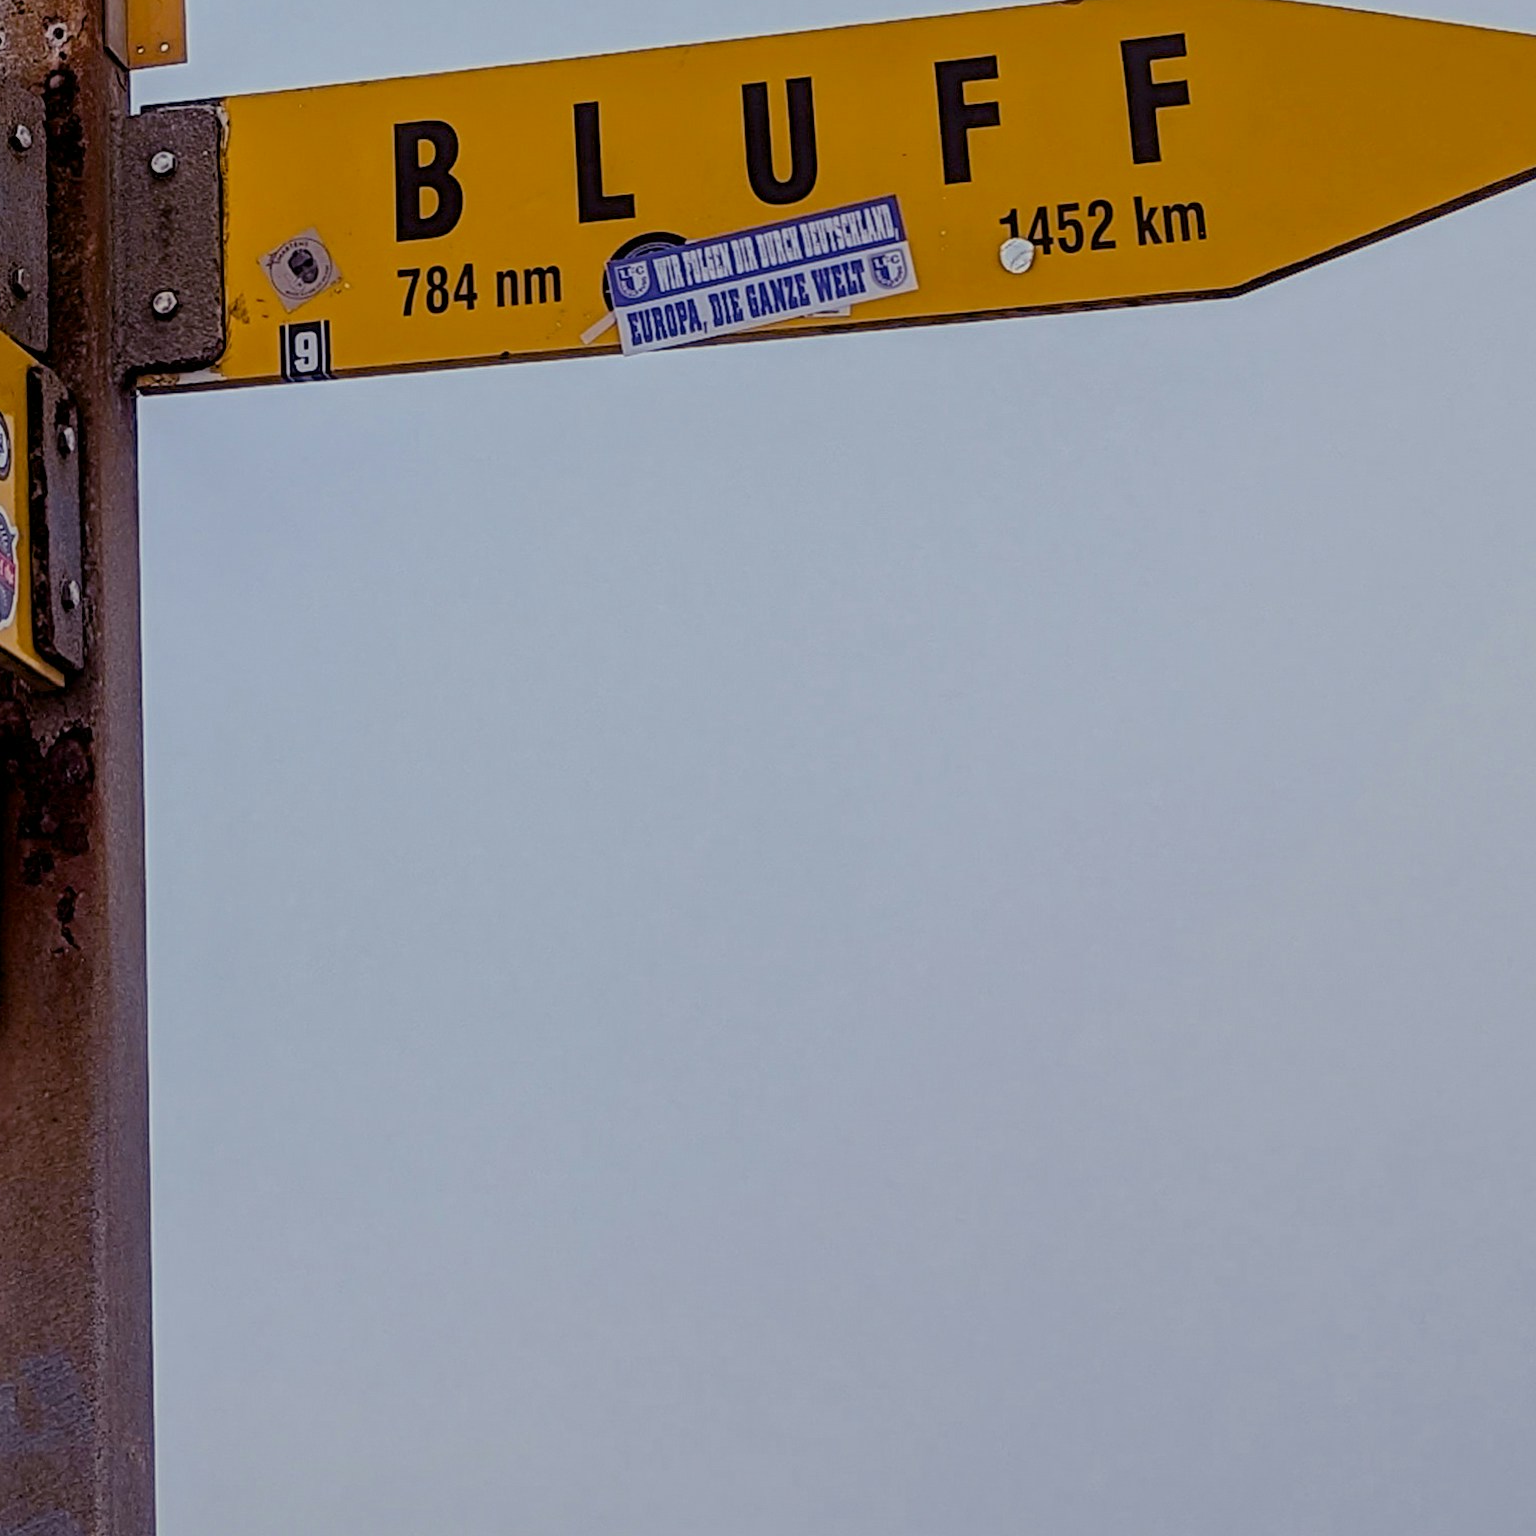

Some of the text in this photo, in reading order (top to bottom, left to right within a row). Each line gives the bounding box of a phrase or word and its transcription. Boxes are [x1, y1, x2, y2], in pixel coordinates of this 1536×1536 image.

[394, 31, 1190, 242] BLUFF
[999, 196, 1207, 255] 1452 km
[397, 265, 477, 317] 784
[496, 264, 561, 309] nm
[652, 251, 683, 293] WIR
[680, 243, 731, 287] FOLGEN
[754, 225, 802, 269] DURCH
[627, 298, 708, 347] EUROPA,
[708, 287, 744, 328] DIE
[746, 273, 810, 319] GANZE
[811, 259, 867, 303] WELT
[294, 331, 318, 373] 9
